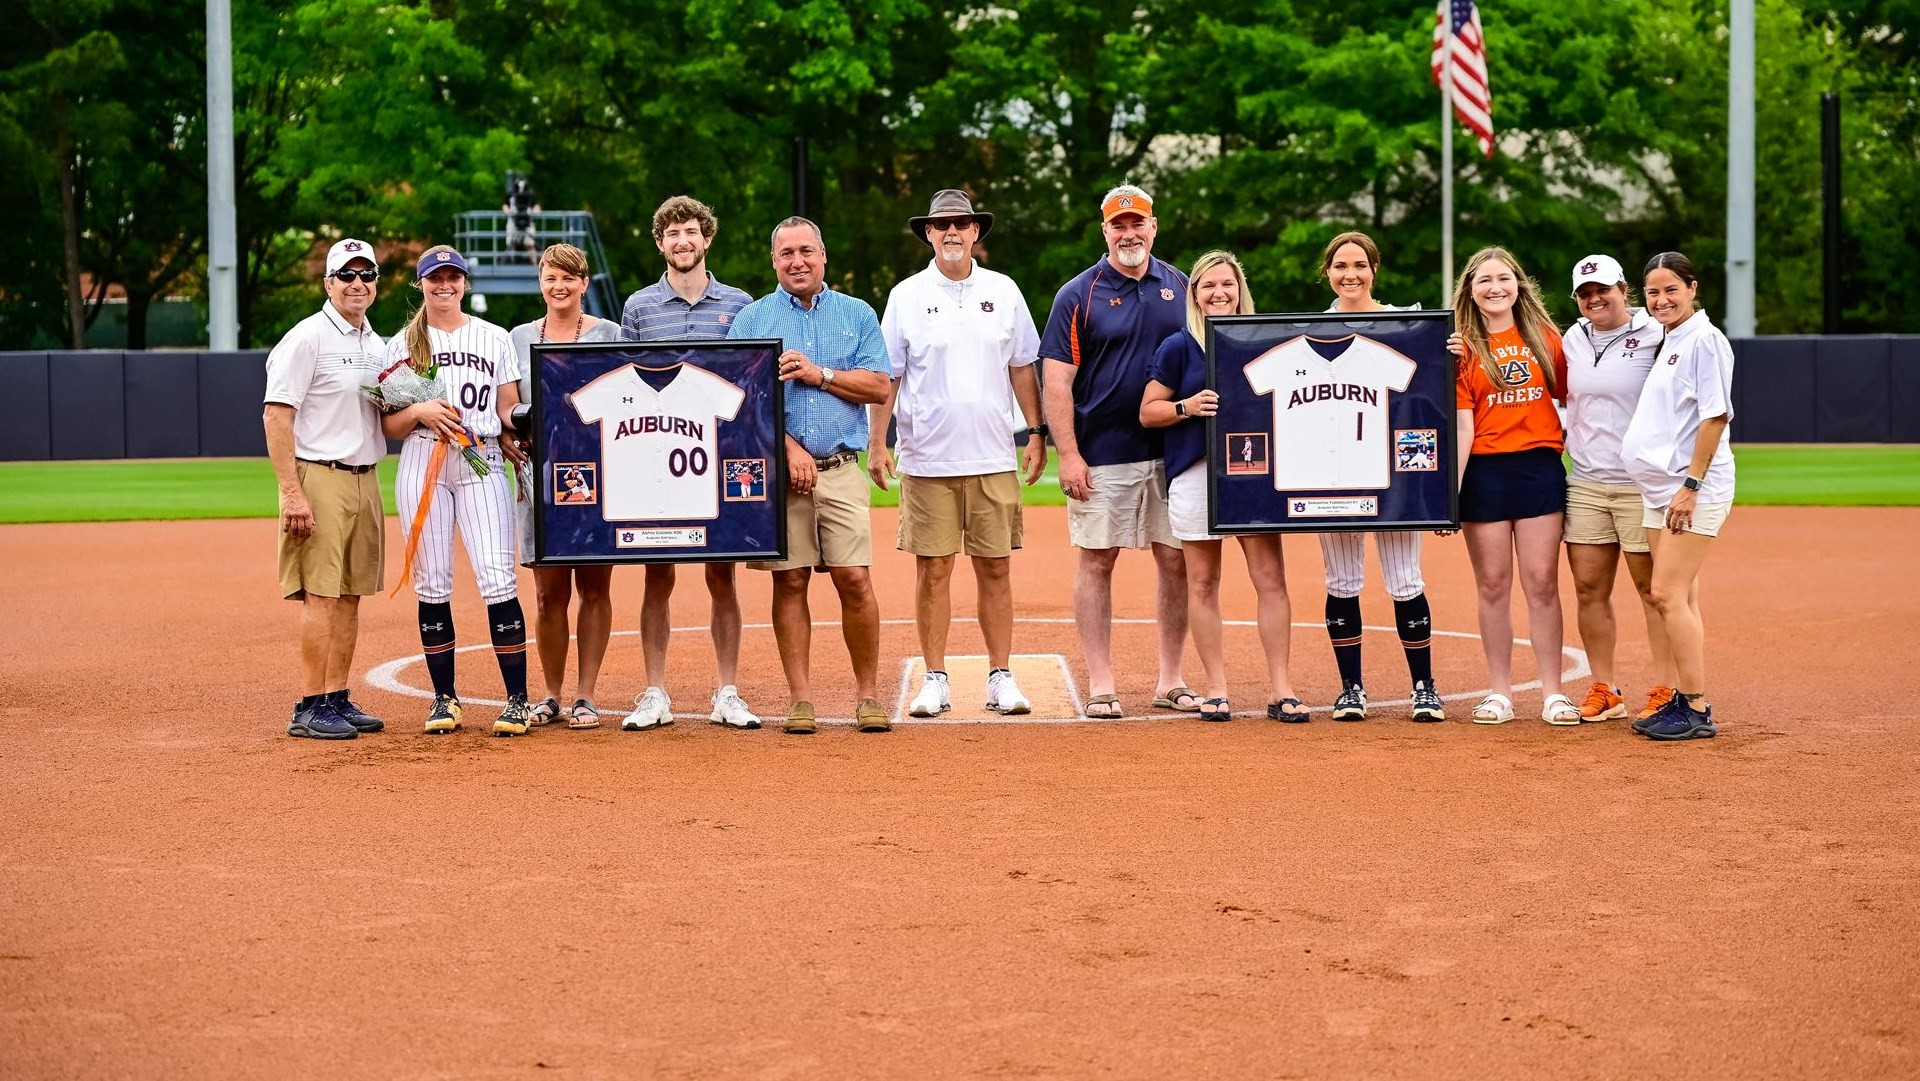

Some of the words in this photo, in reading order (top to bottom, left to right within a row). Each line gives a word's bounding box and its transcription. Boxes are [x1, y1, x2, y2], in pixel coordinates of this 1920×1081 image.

[429, 352, 495, 378] BURN
[1479, 345, 1539, 369] BUR
[460, 382, 491, 412] 00
[1287, 383, 1378, 410] AUBURN
[614, 415, 703, 441] AUBURN
[1356, 411, 1363, 441] 1
[668, 446, 709, 478] 00
